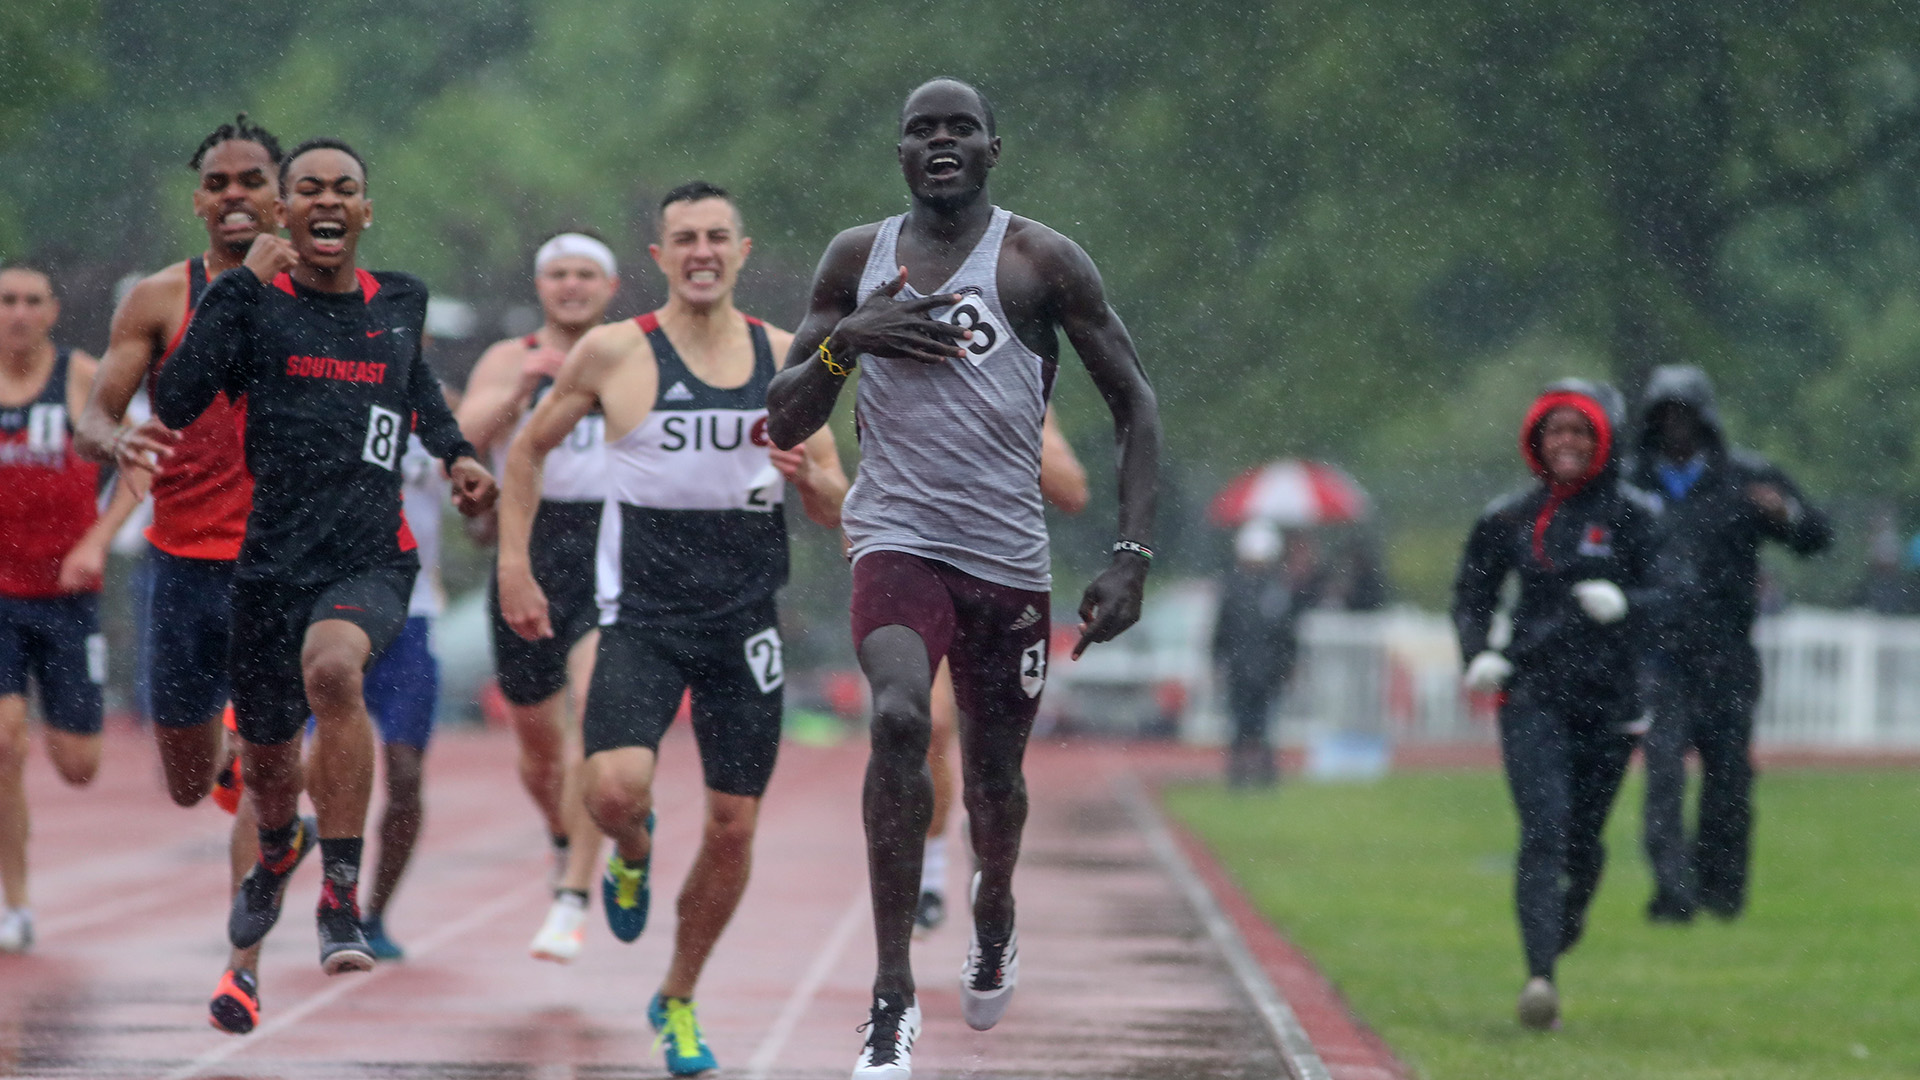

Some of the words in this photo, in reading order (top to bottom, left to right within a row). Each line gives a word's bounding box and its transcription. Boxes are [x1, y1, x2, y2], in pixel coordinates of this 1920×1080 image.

[951, 304, 996, 355] 3
[286, 355, 388, 384] SOUTHEAST
[371, 414, 394, 462] 8
[751, 638, 781, 686] 2
